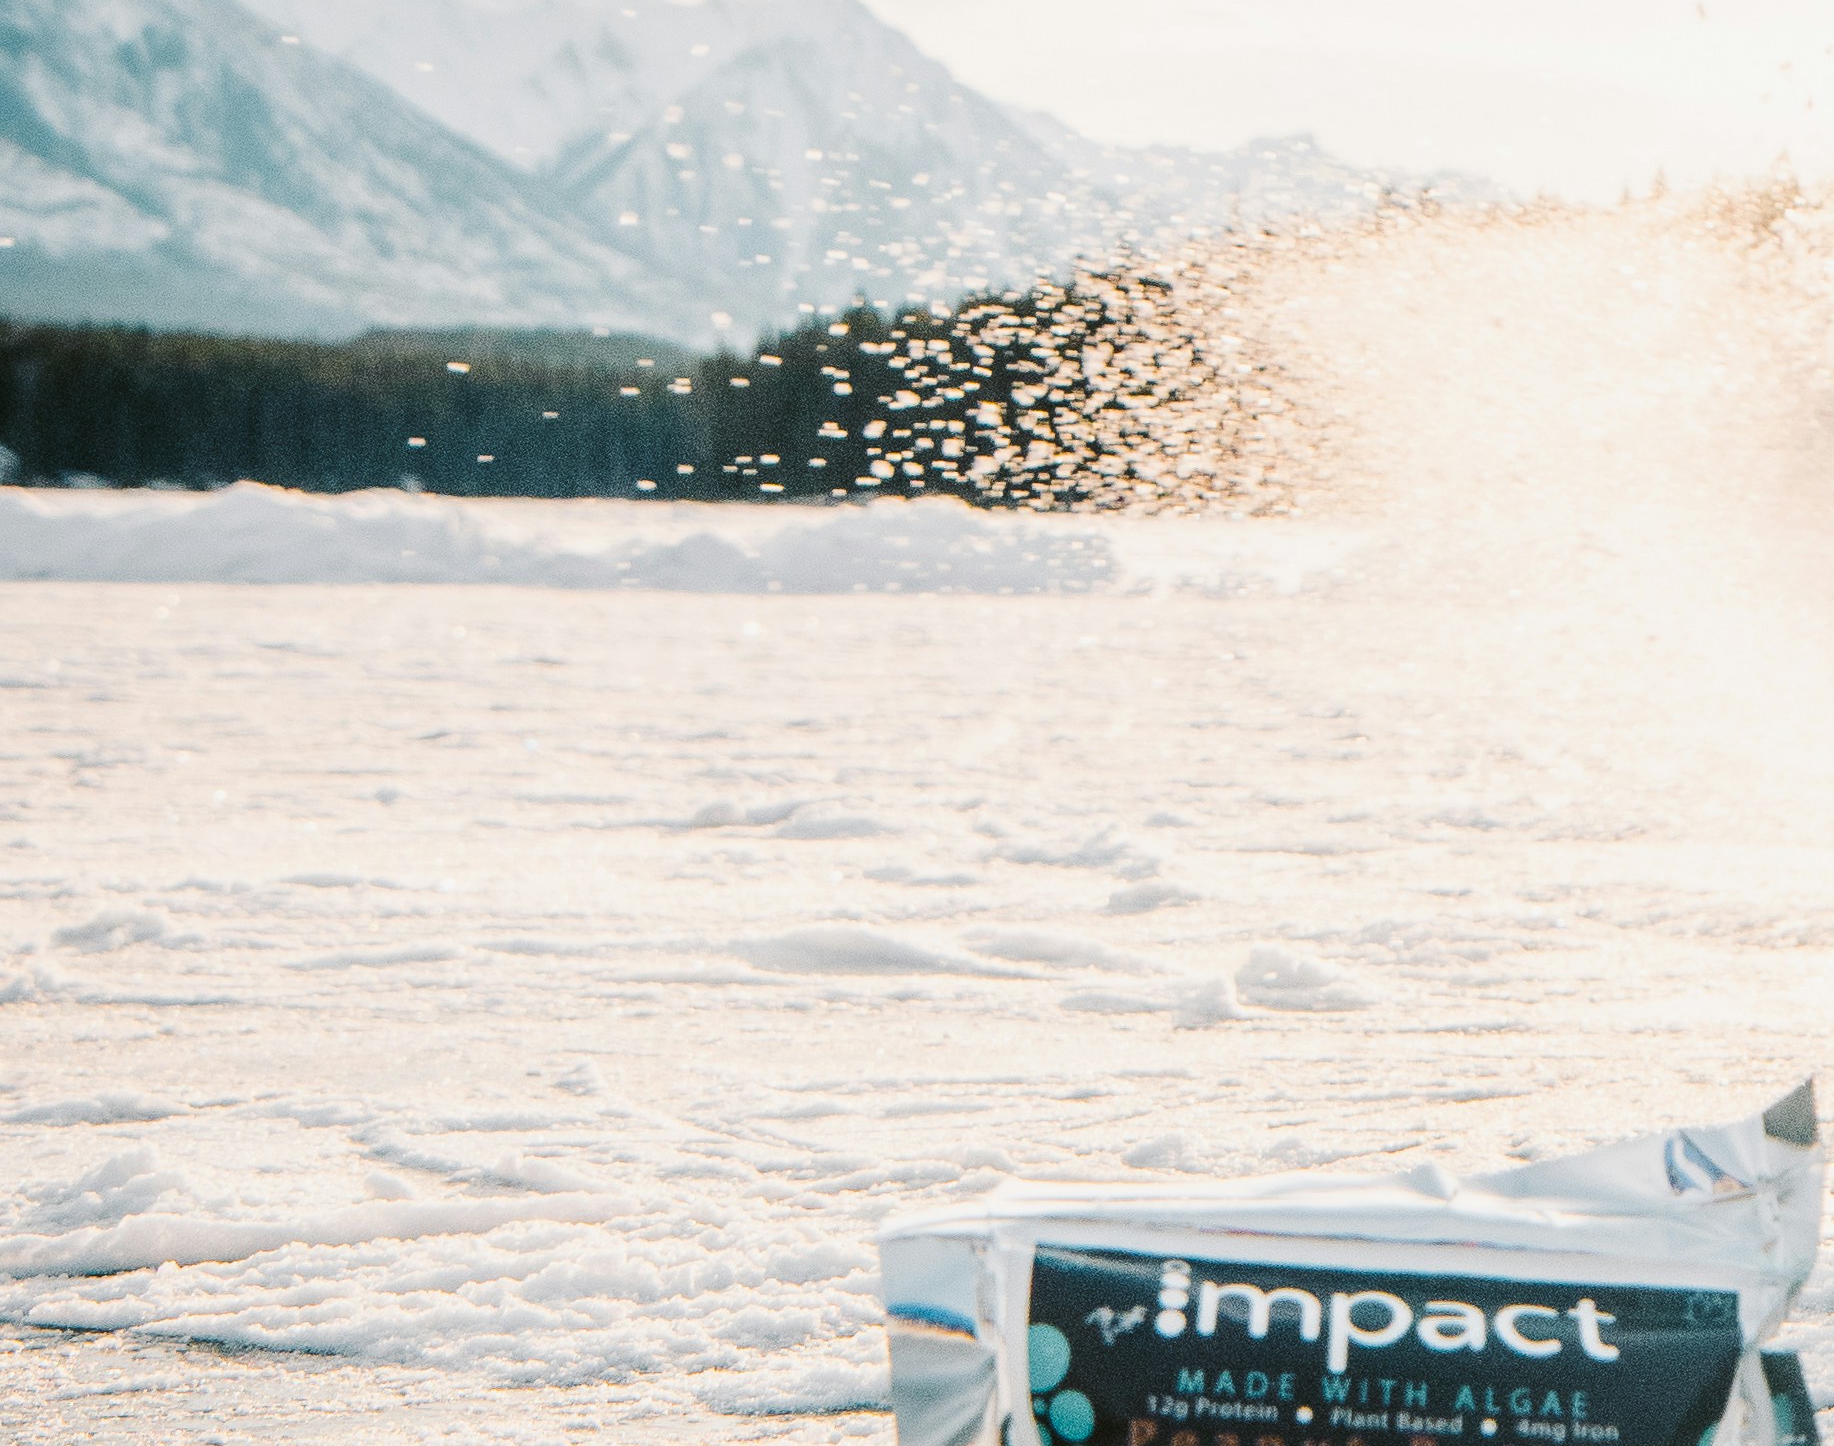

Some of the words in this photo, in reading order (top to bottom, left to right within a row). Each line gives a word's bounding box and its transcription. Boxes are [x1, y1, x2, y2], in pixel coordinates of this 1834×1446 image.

[1154, 1258, 1620, 1375] impact
[1149, 1395, 1190, 1423] 12g
[1195, 1398, 1280, 1423] Protein
[1329, 1405, 1388, 1430] Plant
[1396, 1410, 1464, 1436] Based
[1516, 1418, 1566, 1444] 4mg
[1572, 1419, 1621, 1442] Iron
[1175, 1366, 1296, 1402] MADE
[1321, 1375, 1429, 1408] WITH
[1454, 1384, 1590, 1421] ALGAE
